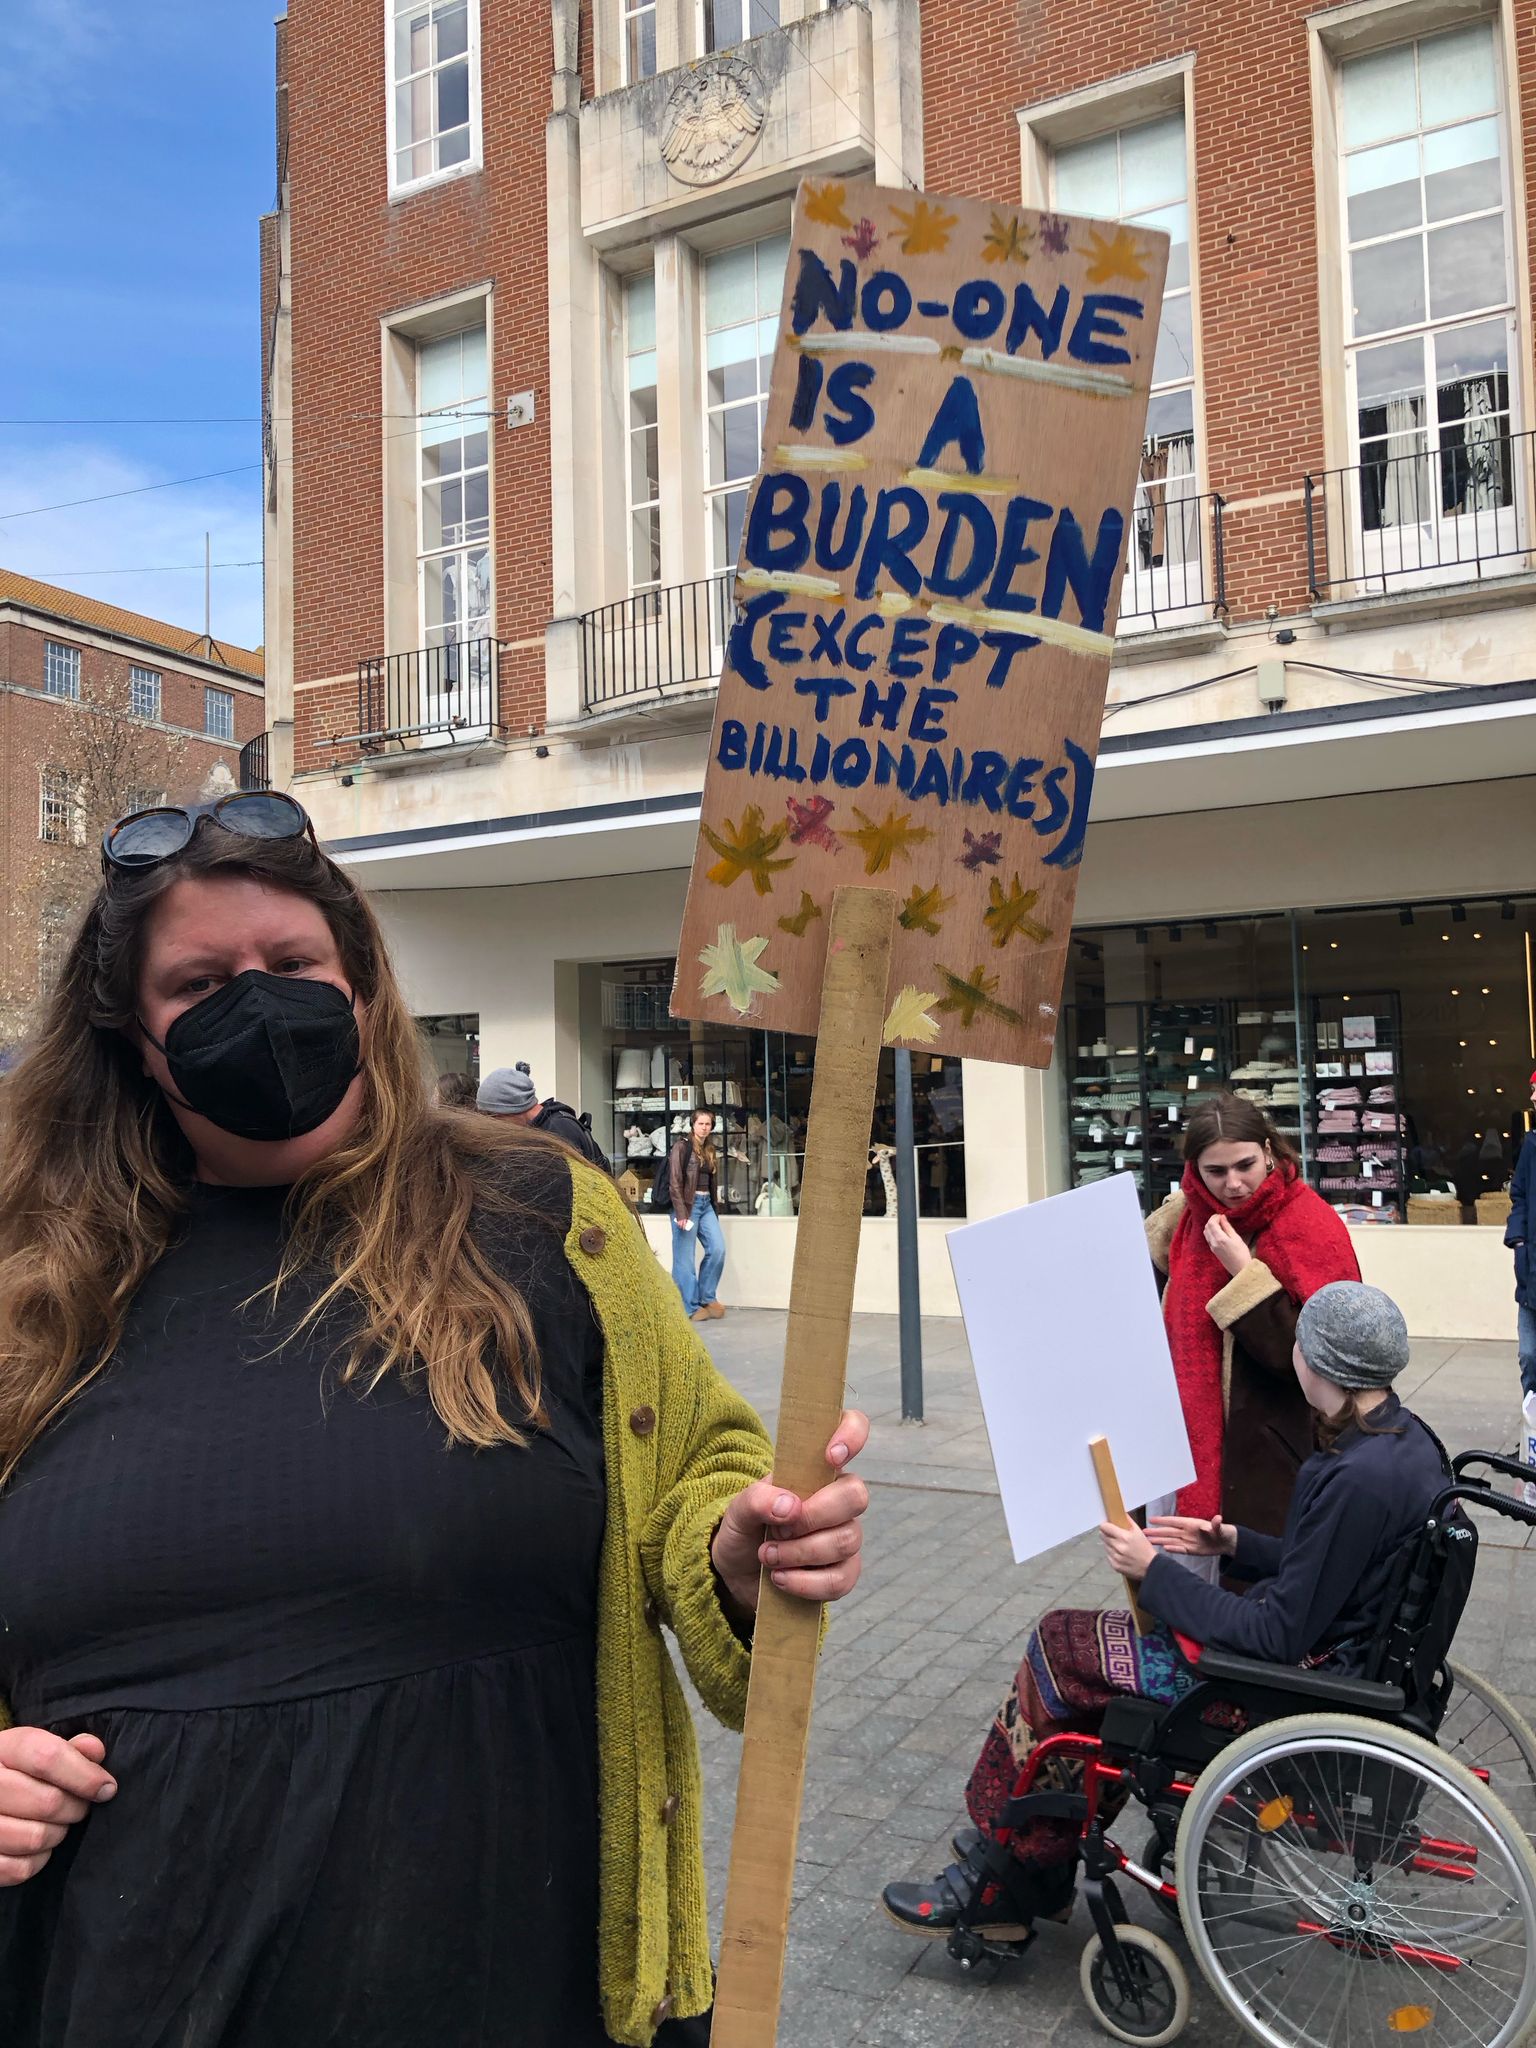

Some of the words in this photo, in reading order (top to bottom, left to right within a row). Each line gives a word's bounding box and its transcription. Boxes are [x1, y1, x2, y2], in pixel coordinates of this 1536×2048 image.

[791, 248, 1144, 365] NO-ONE
[788, 355, 877, 445] IS
[917, 375, 986, 475] A
[745, 472, 1125, 632] BURDEN
[728, 589, 1042, 691] (EXCEPT
[794, 677, 959, 744] THE
[716, 718, 1096, 870] BILLIONAIRES)
